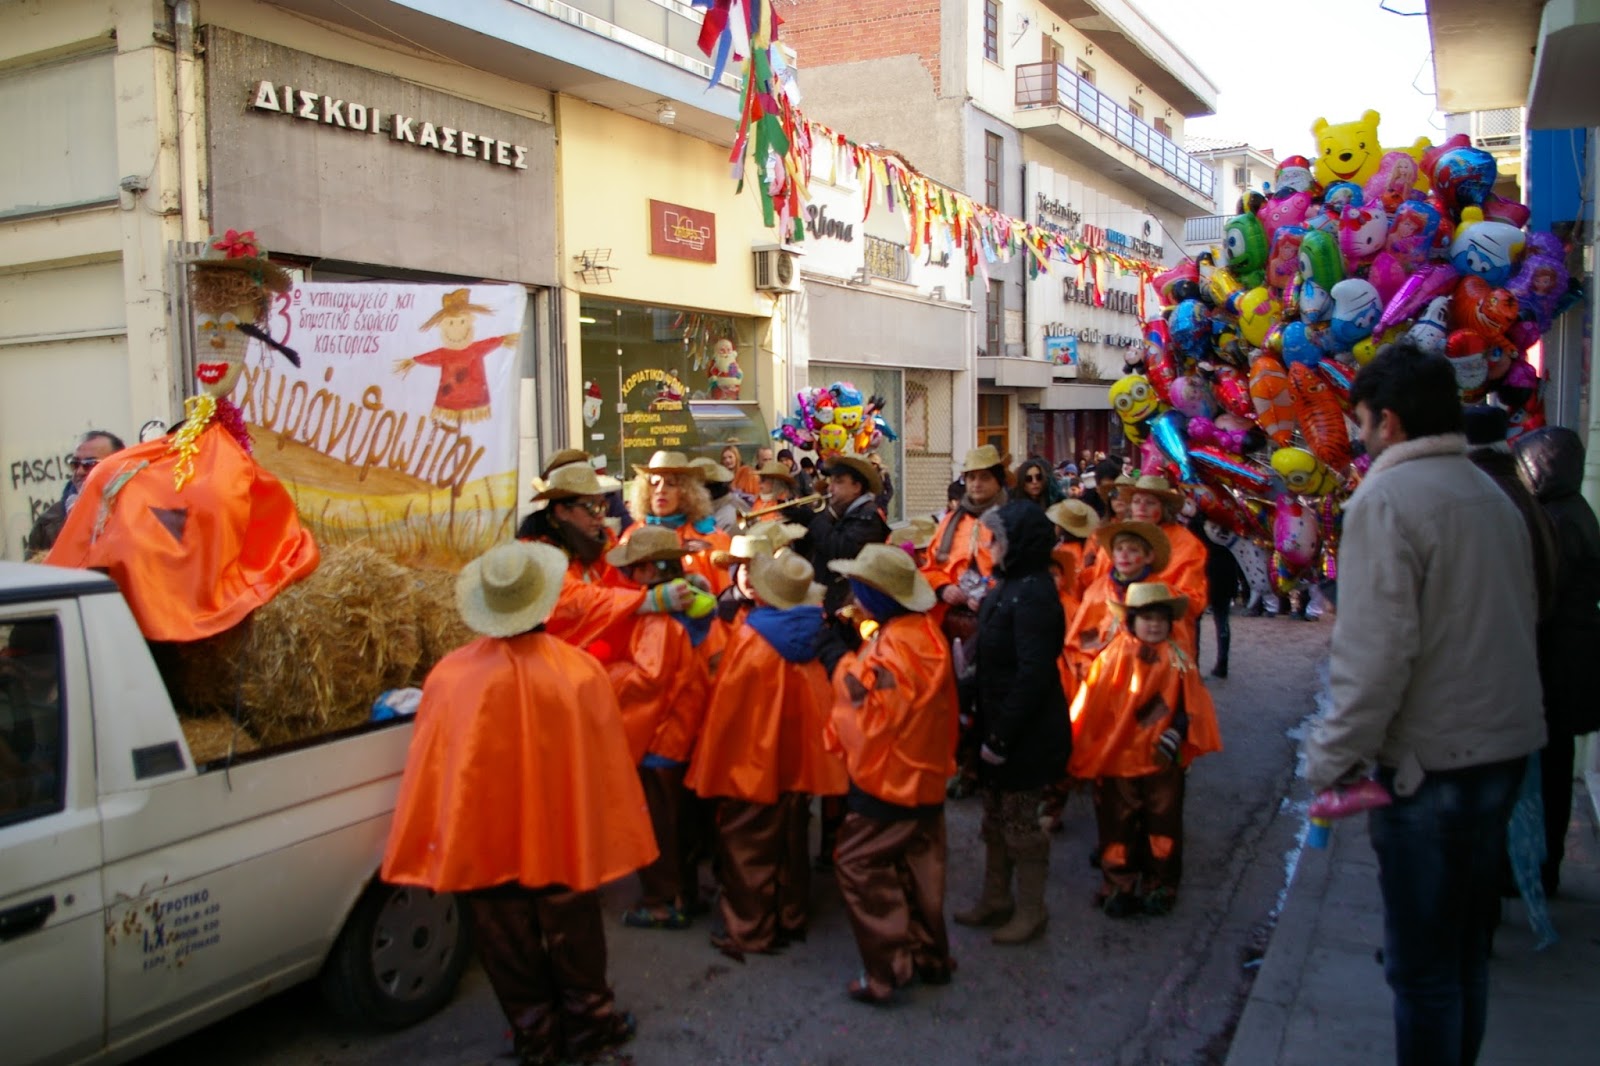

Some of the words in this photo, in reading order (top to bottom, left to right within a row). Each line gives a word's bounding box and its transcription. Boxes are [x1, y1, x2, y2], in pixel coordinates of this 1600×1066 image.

[254, 80, 380, 134] ΔΙΣΚΟΙ
[393, 114, 528, 169] ΚΑΣΕΤΕΣ
[395, 293, 416, 309] και
[231, 362, 485, 498] χυράνθρωποι
